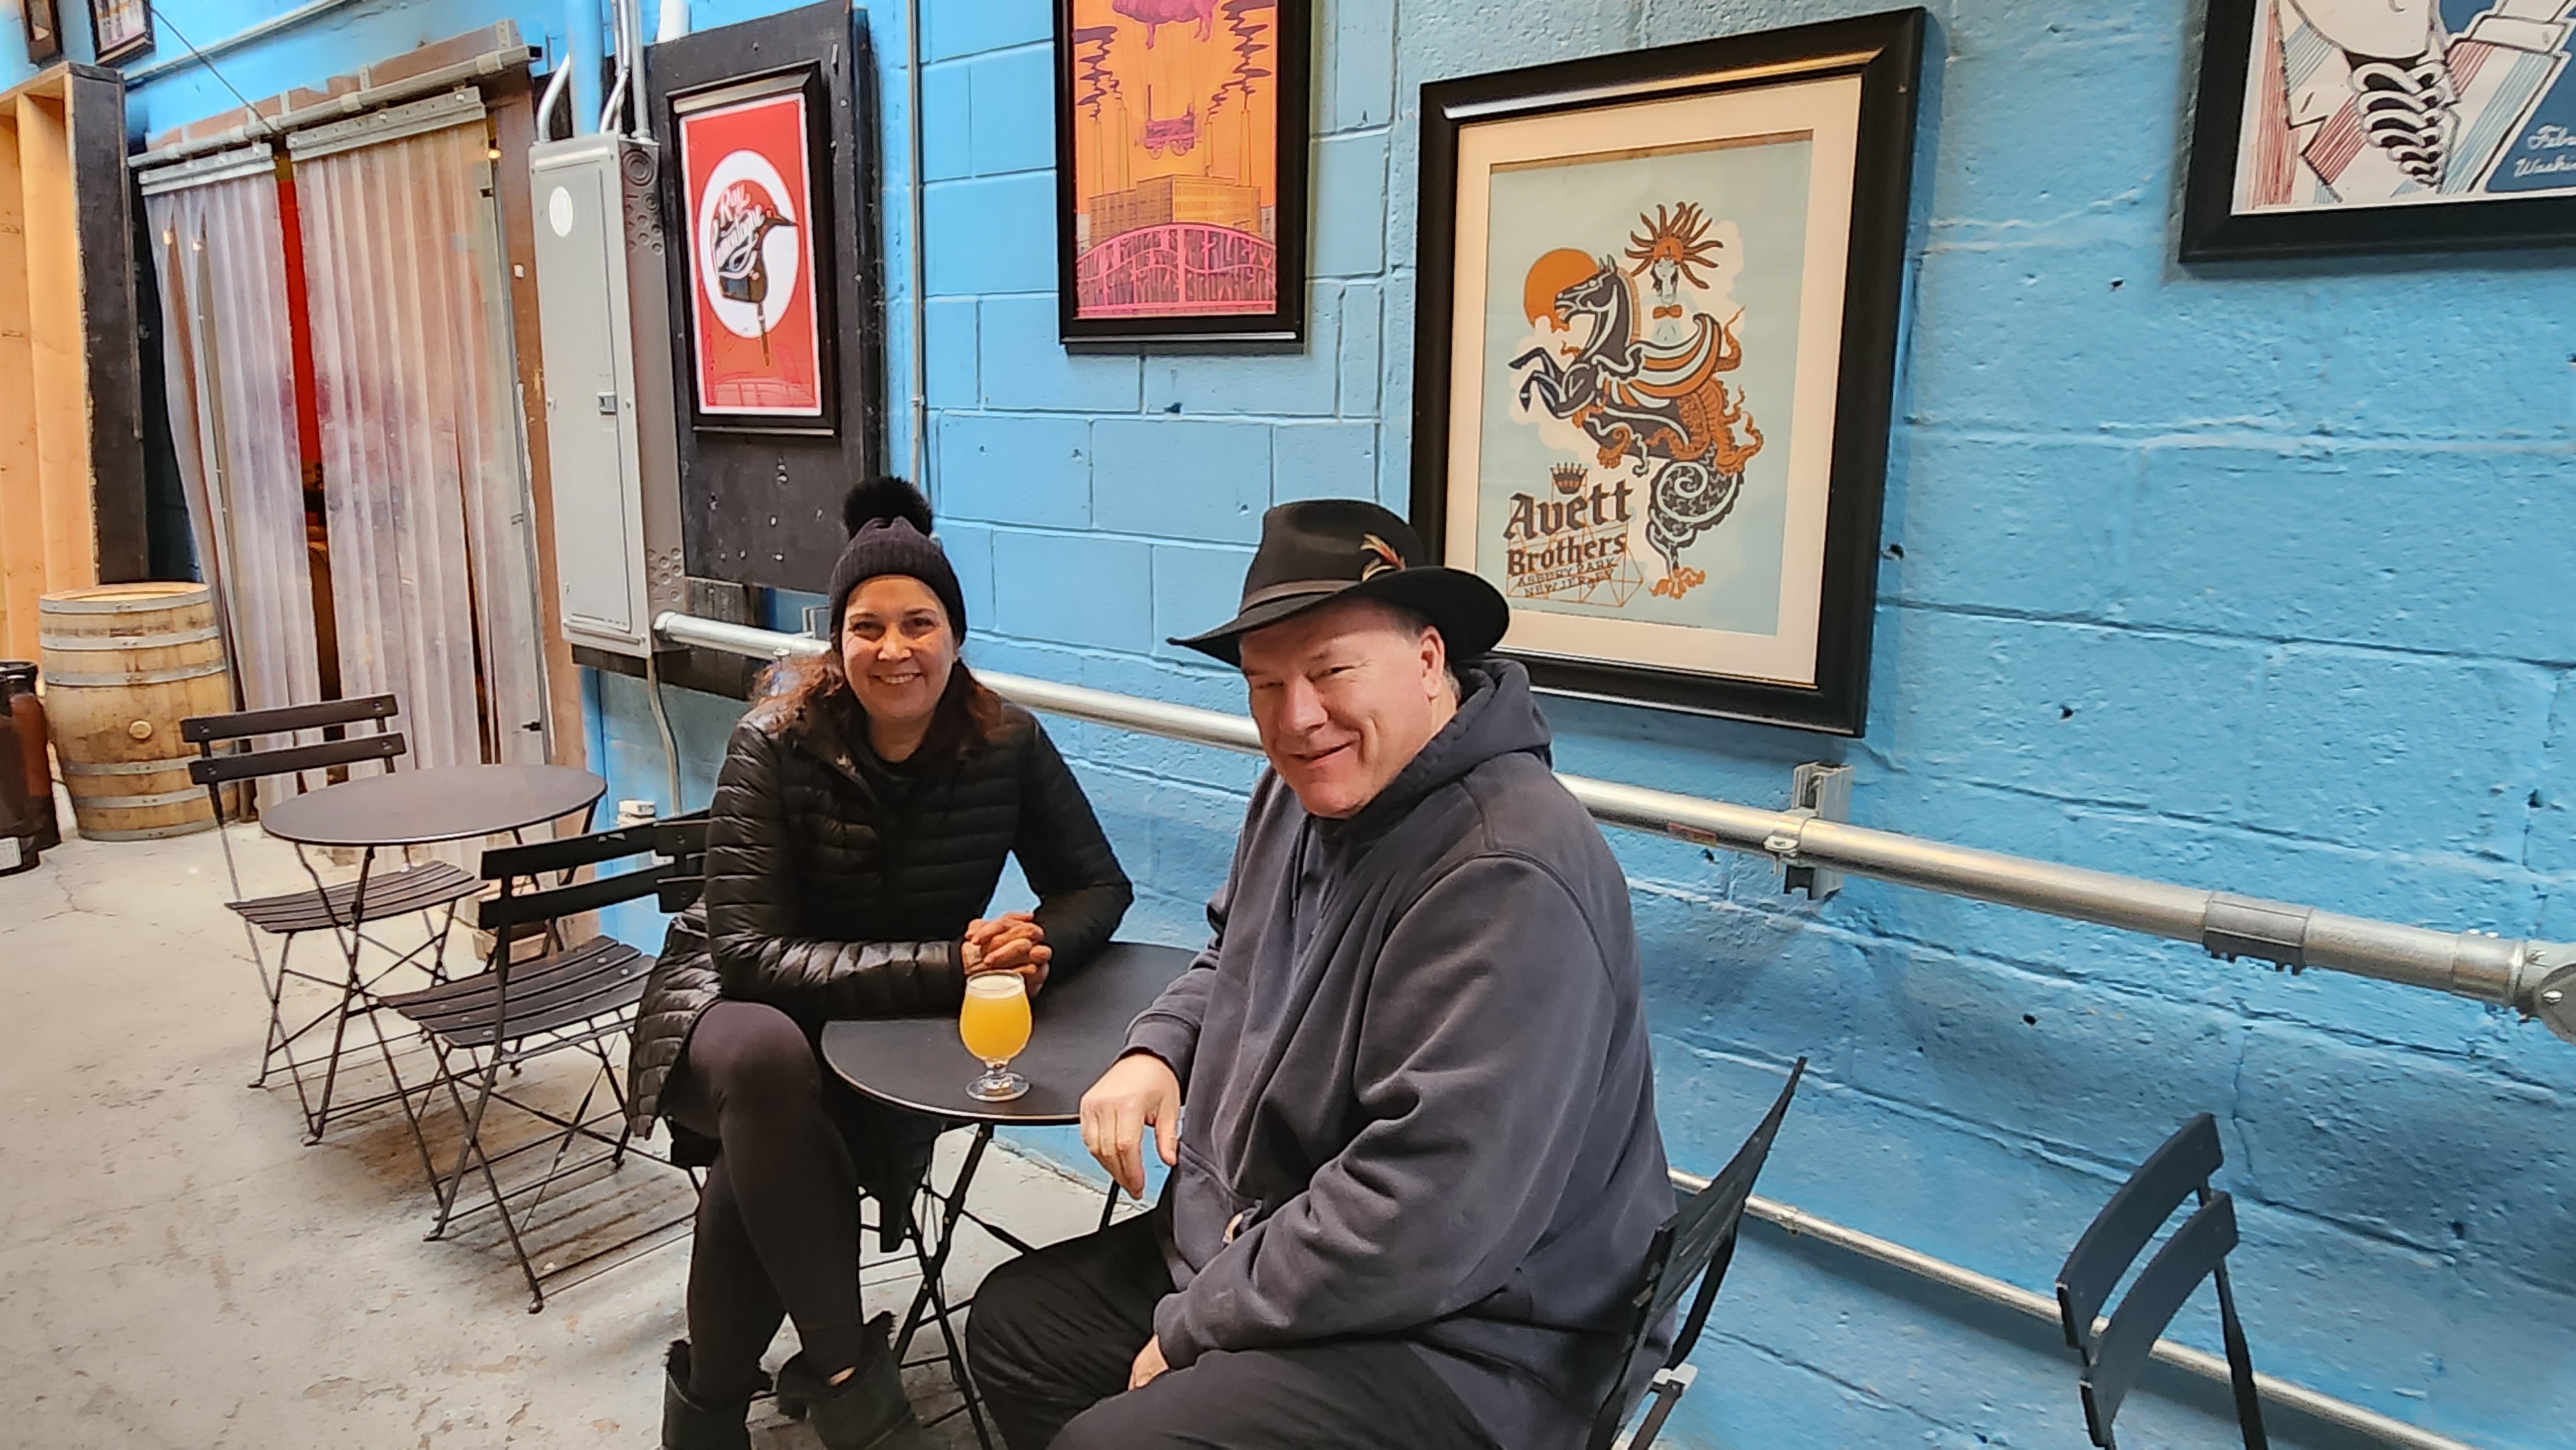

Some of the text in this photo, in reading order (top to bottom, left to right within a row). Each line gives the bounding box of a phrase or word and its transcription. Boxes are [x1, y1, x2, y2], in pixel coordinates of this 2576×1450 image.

[718, 184, 751, 227] Ray
[1503, 480, 1634, 540] Avett
[1507, 532, 1627, 576] Brothers
[1518, 558, 1616, 587] ASBURY PARK
